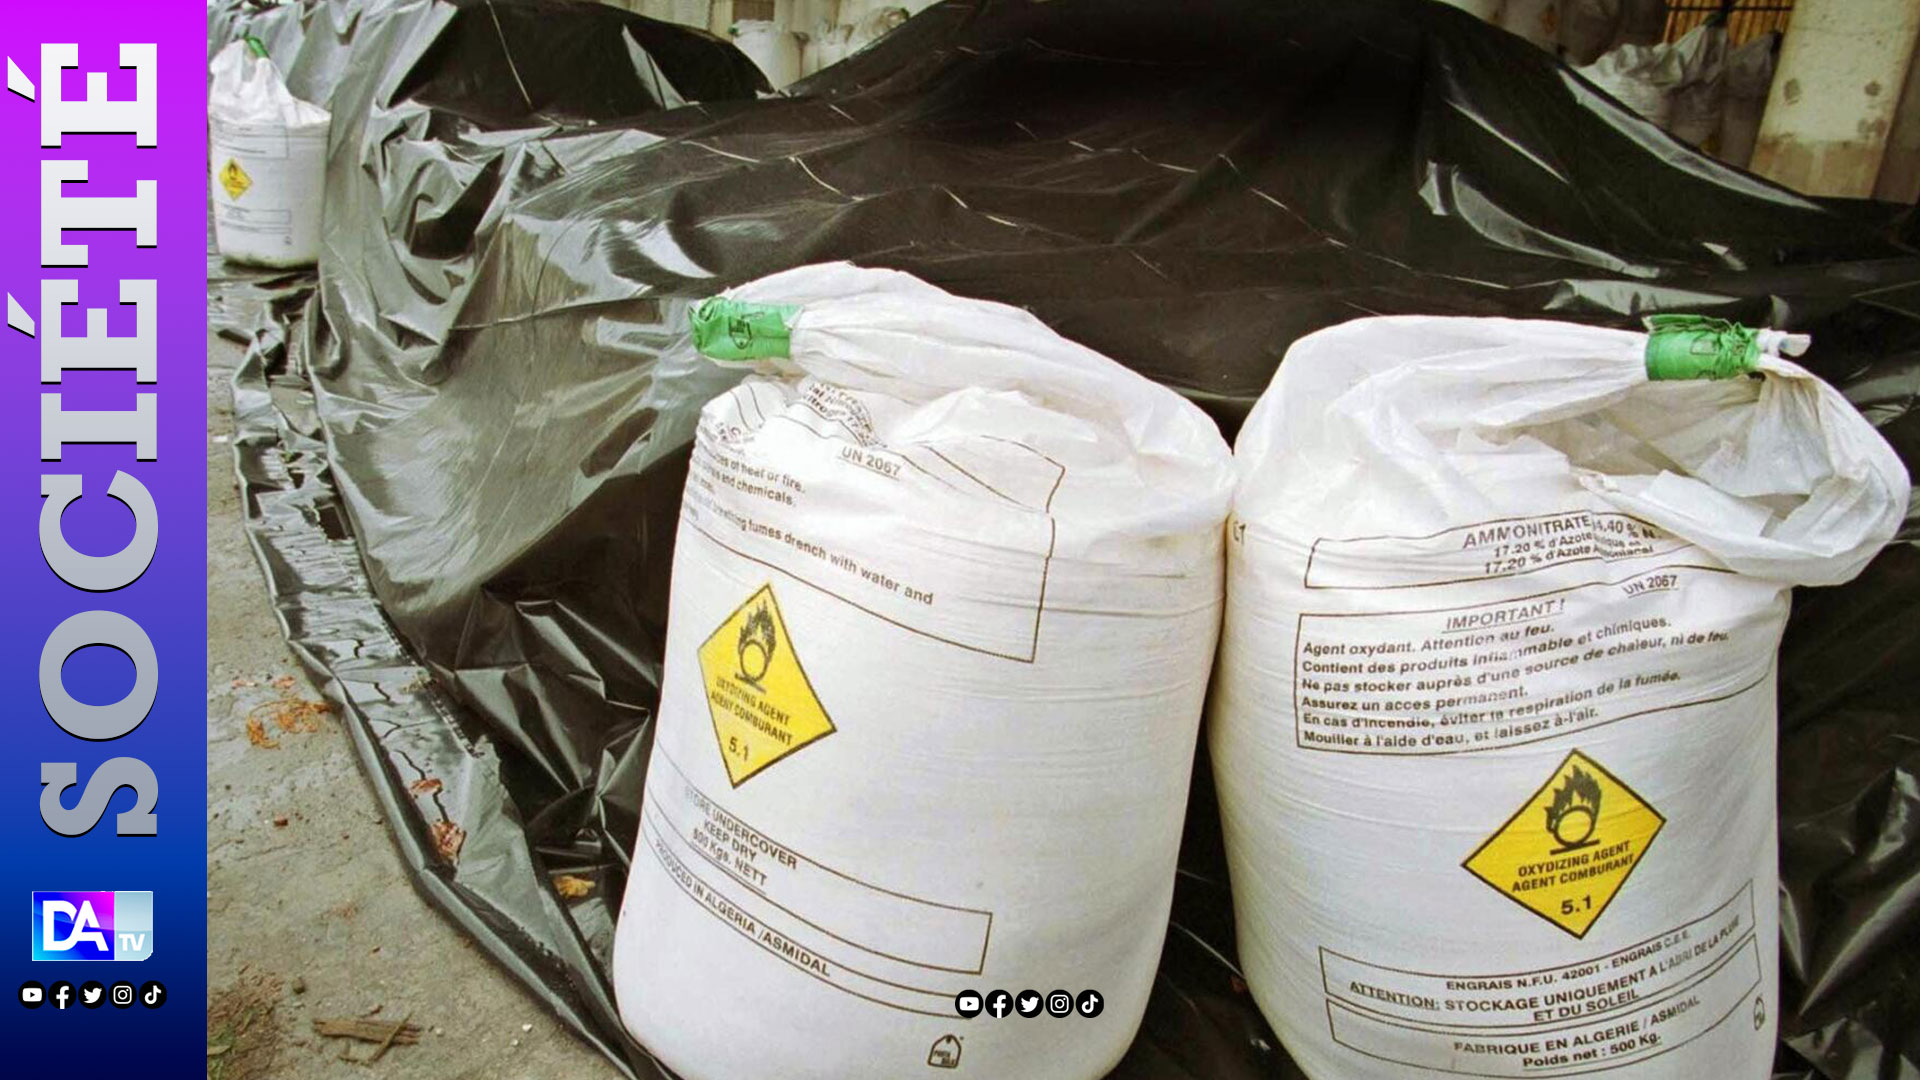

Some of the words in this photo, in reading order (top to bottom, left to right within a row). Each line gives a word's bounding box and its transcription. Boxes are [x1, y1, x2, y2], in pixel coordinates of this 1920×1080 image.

[841, 445, 863, 463] UN
[866, 454, 901, 477] 2067
[1463, 515, 1591, 549] AMMONITRATE
[1494, 541, 1530, 558] 17.20
[748, 518, 781, 540] fumes
[784, 529, 826, 561] drench
[830, 553, 857, 575] with
[860, 566, 901, 592] water
[904, 584, 934, 605] and
[1484, 556, 1526, 574] 17.20
[1622, 582, 1645, 596] UN
[1647, 575, 1678, 590] 2067
[1446, 600, 1556, 630] IMPORTANT
[1302, 659, 1363, 675] Contient
[1367, 660, 1395, 674] des
[1399, 656, 1469, 676] produits
[1578, 631, 1592, 646] et
[1596, 615, 1671, 640] chimiques.
[1303, 642, 1345, 657] Agent
[1349, 641, 1416, 658] oxydant.
[1421, 633, 1495, 652] Attention
[1499, 630, 1521, 641] au
[1524, 623, 1554, 640] feu.
[1301, 678, 1320, 691] Ne
[1324, 681, 1350, 694] pas
[1354, 678, 1411, 693] stocker
[1416, 674, 1472, 693] auprès
[1477, 666, 1521, 685] d'une
[1524, 655, 1579, 676] source
[1583, 646, 1603, 661] de
[1607, 636, 1667, 656] chaleur,
[1670, 633, 1685, 646] ni
[1687, 630, 1705, 644] de
[758, 700, 792, 727] AGENT
[1301, 696, 1358, 711] Assurez
[1361, 700, 1380, 711] un
[1435, 686, 1528, 711] permanent.
[1303, 712, 1320, 726] En
[1323, 716, 1347, 728] cas
[1352, 714, 1436, 730] d'incendie,
[1440, 709, 1486, 727] éviter
[1508, 689, 1593, 717] respiration
[1596, 680, 1615, 695] de
[1618, 677, 1631, 691] la
[735, 702, 794, 746] COMBURANT
[1304, 731, 1359, 746] Mouiller
[1363, 734, 1373, 747] à
[1474, 729, 1490, 742] et
[1494, 718, 1551, 739] laissez
[728, 736, 749, 762] 5.1
[704, 818, 730, 843] KEEP
[732, 839, 758, 862] DRY
[713, 808, 799, 870] UNDERCOVER
[734, 858, 768, 887] NETT
[1512, 875, 1556, 892] AGENT
[1560, 853, 1634, 884] COMBURANT
[1518, 853, 1590, 877] OXYDIZING
[1593, 840, 1631, 861] AGENT
[693, 882, 705, 899] IN
[705, 892, 756, 935] ALGERIA
[1561, 894, 1592, 915] 5.1
[1349, 980, 1440, 1010] ATTENTION:
[1444, 997, 1540, 1012] STOCKAGE
[1544, 969, 1646, 1007] UNIQUEMENT
[1649, 964, 1658, 978] A
[1694, 941, 1707, 956] DE
[1708, 934, 1719, 949] LA
[1446, 979, 1513, 991] ENGRAIS
[1517, 975, 1558, 988] N.F.U.
[1561, 965, 1600, 980] 42001
[1611, 941, 1663, 968] ENGRAIS
[1533, 1008, 1553, 1022] ET
[1559, 1003, 1582, 1018] DU
[1586, 989, 1640, 1013] SOLEIL
[1454, 1040, 1541, 1056] FABRIQUE
[1545, 1037, 1568, 1052] EN
[1572, 1020, 1640, 1048] ALGERIE
[1650, 994, 1701, 1027] ASMIDAL
[1522, 1053, 1568, 1067] Poids
[1573, 1048, 1598, 1062] net
[1610, 1039, 1636, 1054] 500
[1639, 1030, 1661, 1046] Kg.
